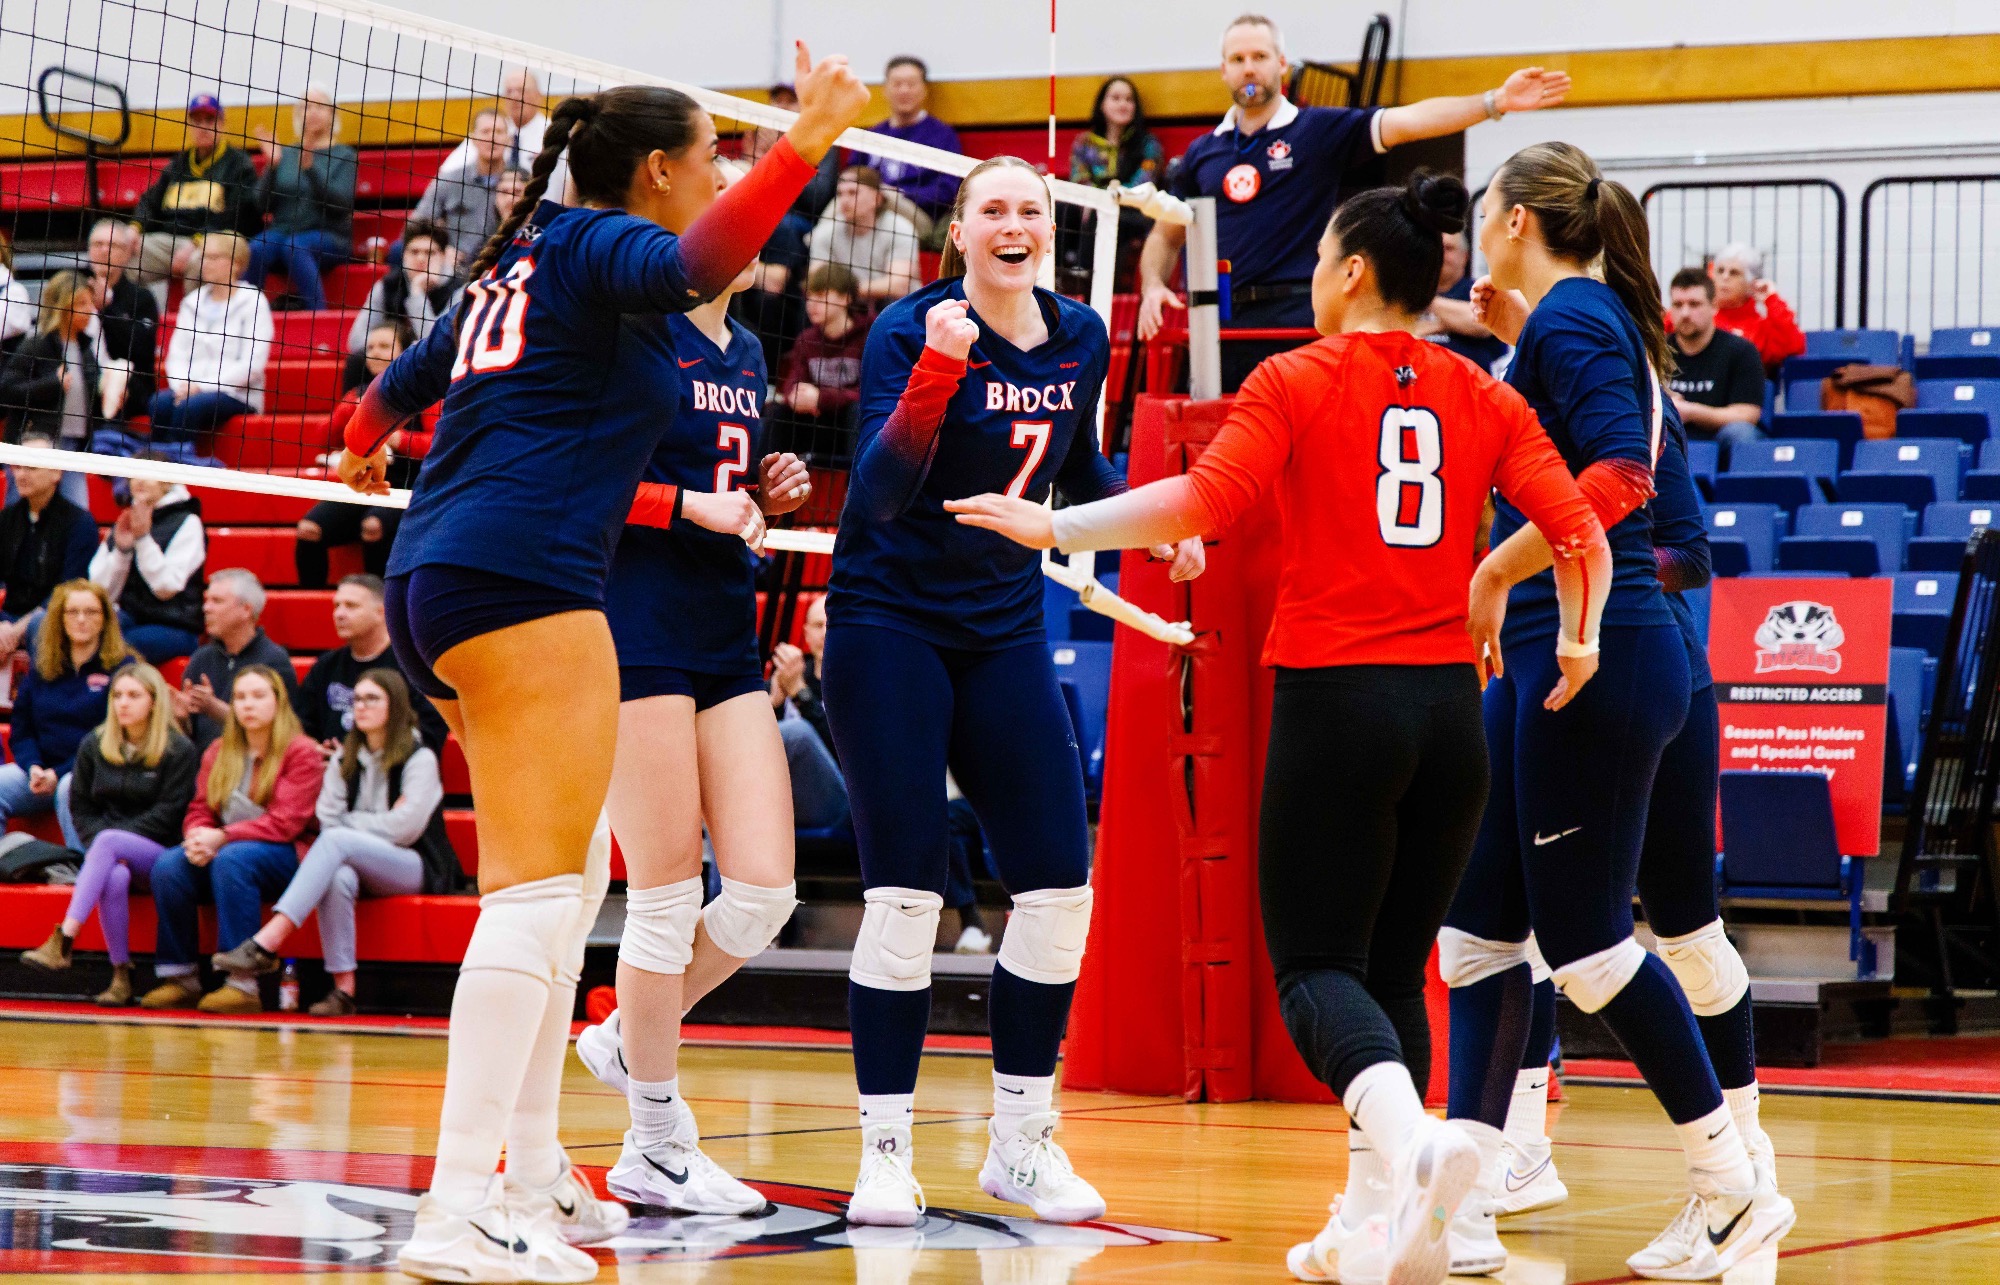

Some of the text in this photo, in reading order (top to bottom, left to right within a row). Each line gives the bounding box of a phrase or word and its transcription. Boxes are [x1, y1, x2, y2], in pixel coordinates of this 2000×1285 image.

[450, 255, 536, 384] 10
[692, 380, 760, 419] BROCK
[985, 381, 1077, 413] BROCK
[713, 421, 753, 494] 2
[1001, 420, 1053, 499] 7
[1376, 404, 1445, 549] 8
[1730, 687, 1862, 702] RESTRICTED ACCESS
[1724, 725, 1865, 741] Season Pass Holders
[1731, 745, 1855, 761] and Special Guest
